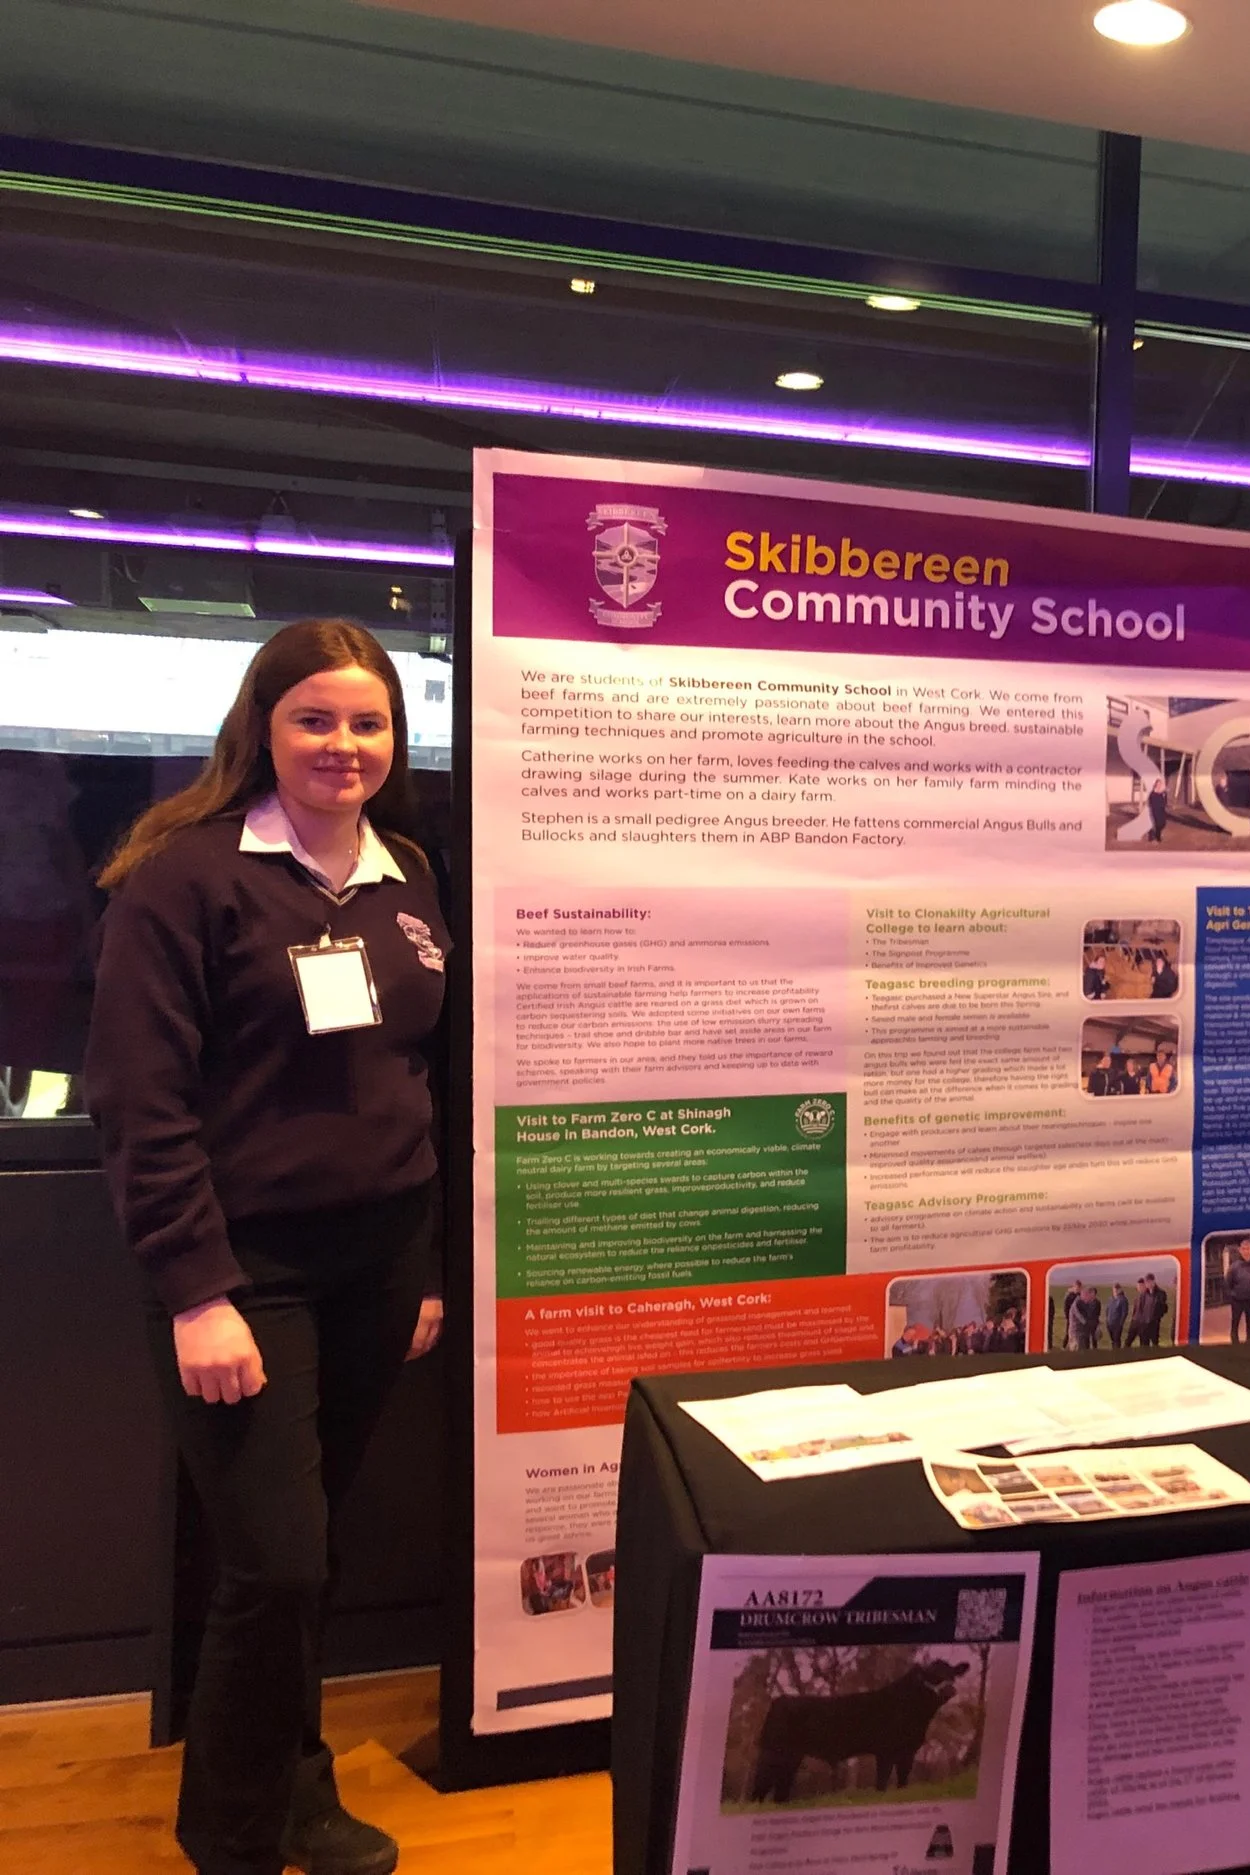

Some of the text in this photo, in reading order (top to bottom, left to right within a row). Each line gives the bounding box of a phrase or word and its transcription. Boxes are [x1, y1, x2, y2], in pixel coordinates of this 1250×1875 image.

[725, 531, 1009, 587] Skibbereen
[724, 579, 1186, 641] Community School
[521, 670, 546, 681] We
[551, 674, 575, 683] are
[580, 674, 645, 685] students
[669, 677, 752, 689] Skibbereen
[757, 680, 839, 695] Community
[844, 684, 891, 695] School
[912, 687, 945, 697] West
[989, 690, 1010, 700] We
[1014, 693, 1049, 702] come
[1053, 693, 1083, 703] from
[521, 688, 554, 699] beef
[562, 689, 604, 702] farms
[611, 692, 639, 702] and
[646, 695, 670, 704] are
[676, 695, 747, 708] extremely
[755, 699, 829, 709] passionate
[836, 700, 875, 711] about
[882, 702, 912, 712] beef
[979, 705, 1000, 716] We
[1006, 708, 1055, 718] entered
[1061, 708, 1084, 720] this
[521, 708, 613, 719] competition
[617, 709, 632, 720] to
[636, 709, 676, 721] share
[680, 713, 704, 722] our
[708, 713, 773, 725] interests,
[777, 714, 811, 725] learn
[815, 718, 851, 727] more
[854, 717, 893, 728] about
[898, 719, 920, 729] the
[923, 719, 966, 733] Angus
[1013, 724, 1084, 735] sustainable
[521, 723, 936, 746] farming techniques and promote agriculture in the school.
[521, 812, 1083, 832] Stephen is a small pedigree Angus breeder. He fattens commercial Angus Bulls and
[522, 829, 584, 841] Bullocks
[589, 830, 617, 841] and
[621, 831, 696, 842] slaughters
[701, 832, 738, 842] them
[742, 834, 755, 842] in
[759, 832, 791, 843] ABP
[795, 832, 848, 843] Bandon
[516, 908, 651, 920] Beef Sustainability:
[866, 908, 1051, 920] Visit to Clonakilty Agricultural
[1206, 905, 1231, 916] Visit
[1233, 906, 1246, 916] to
[866, 923, 1007, 935] College to learn about:
[1205, 919, 1230, 932] Agri
[865, 978, 1050, 990] Teagasc breeding programme:
[516, 1107, 731, 1126] Visit to Farm Zero C at Shinagh
[863, 1108, 1066, 1126] Benefits of genetic improvement:
[517, 1123, 716, 1141] House in Bandon, West Cork.
[864, 1192, 1048, 1211] Teagasc Advisory Programme:
[524, 1293, 772, 1320] A farm visit to Caheragh, West Cork:
[525, 1462, 620, 1478] Women in Ag
[745, 1589, 825, 1607] AA8172
[739, 1608, 939, 1627] DRUMCROW TRIBESMAN
